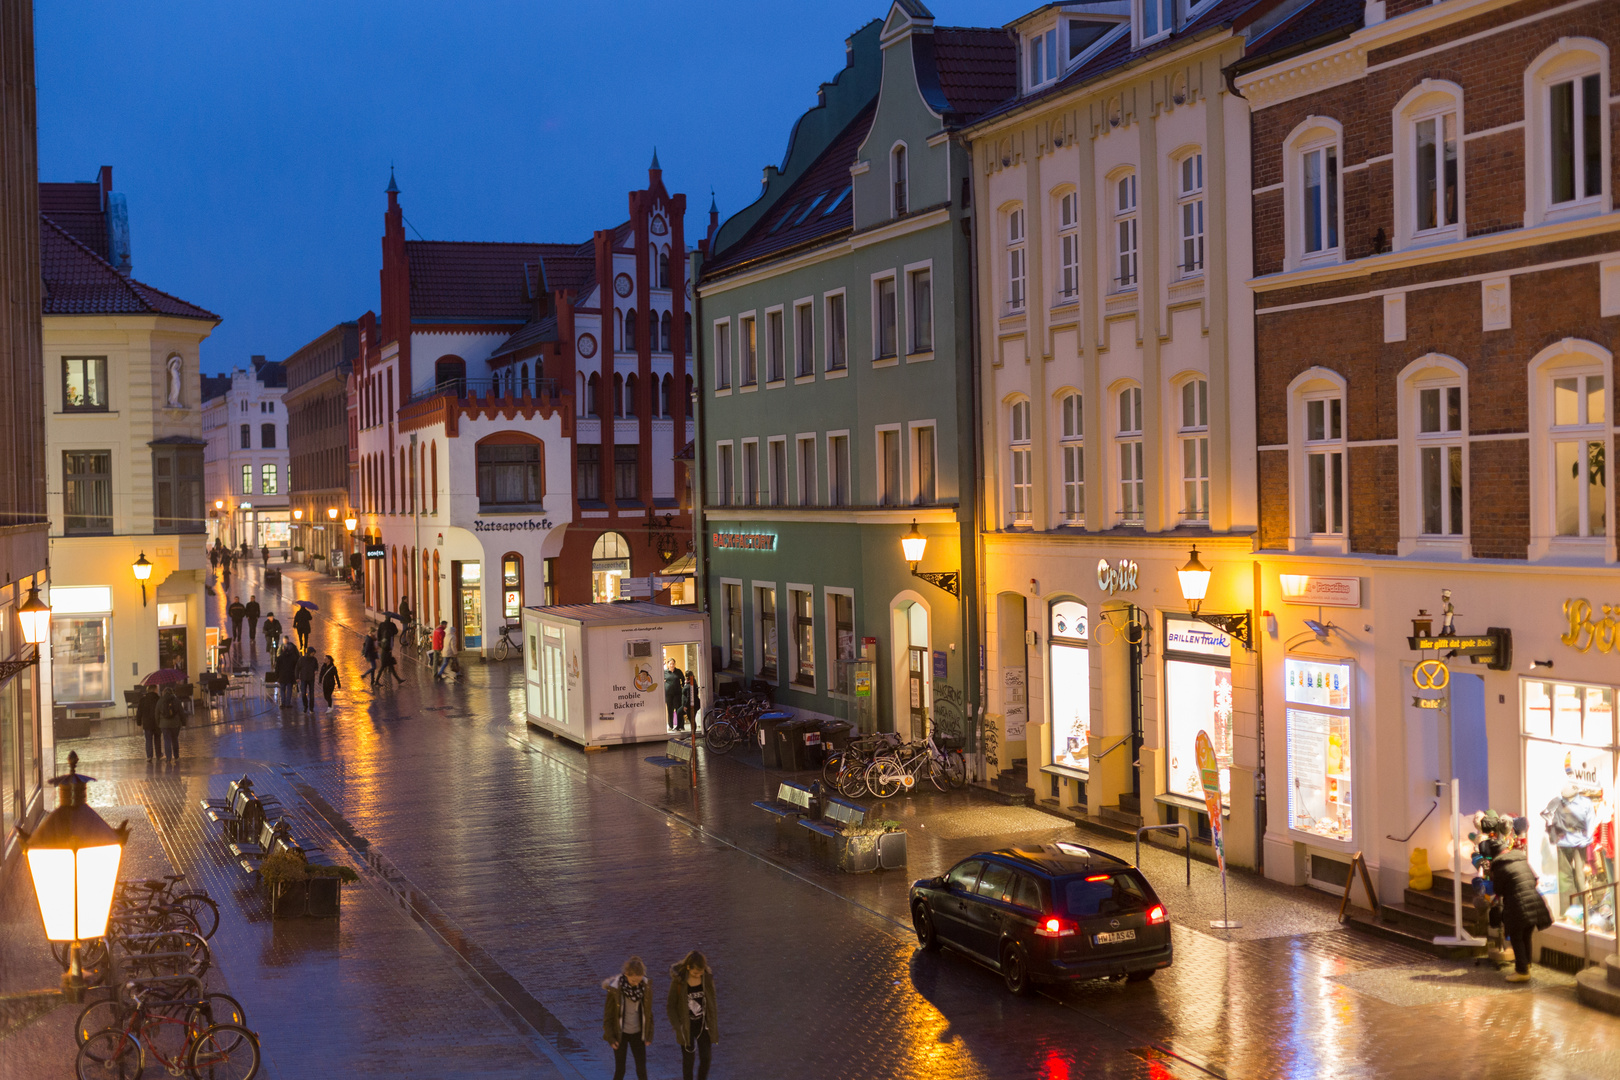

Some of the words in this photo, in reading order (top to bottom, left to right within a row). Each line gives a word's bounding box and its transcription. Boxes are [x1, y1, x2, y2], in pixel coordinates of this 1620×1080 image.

[474, 518, 553, 533] Ratsapotheke
[1561, 598, 1620, 653] Bö
[1168, 633, 1200, 644] BRILLEN
[1188, 630, 1230, 647] Frank
[1449, 640, 1460, 648] dat
[618, 693, 641, 701] mobile
[613, 701, 645, 710] Bäckerei!
